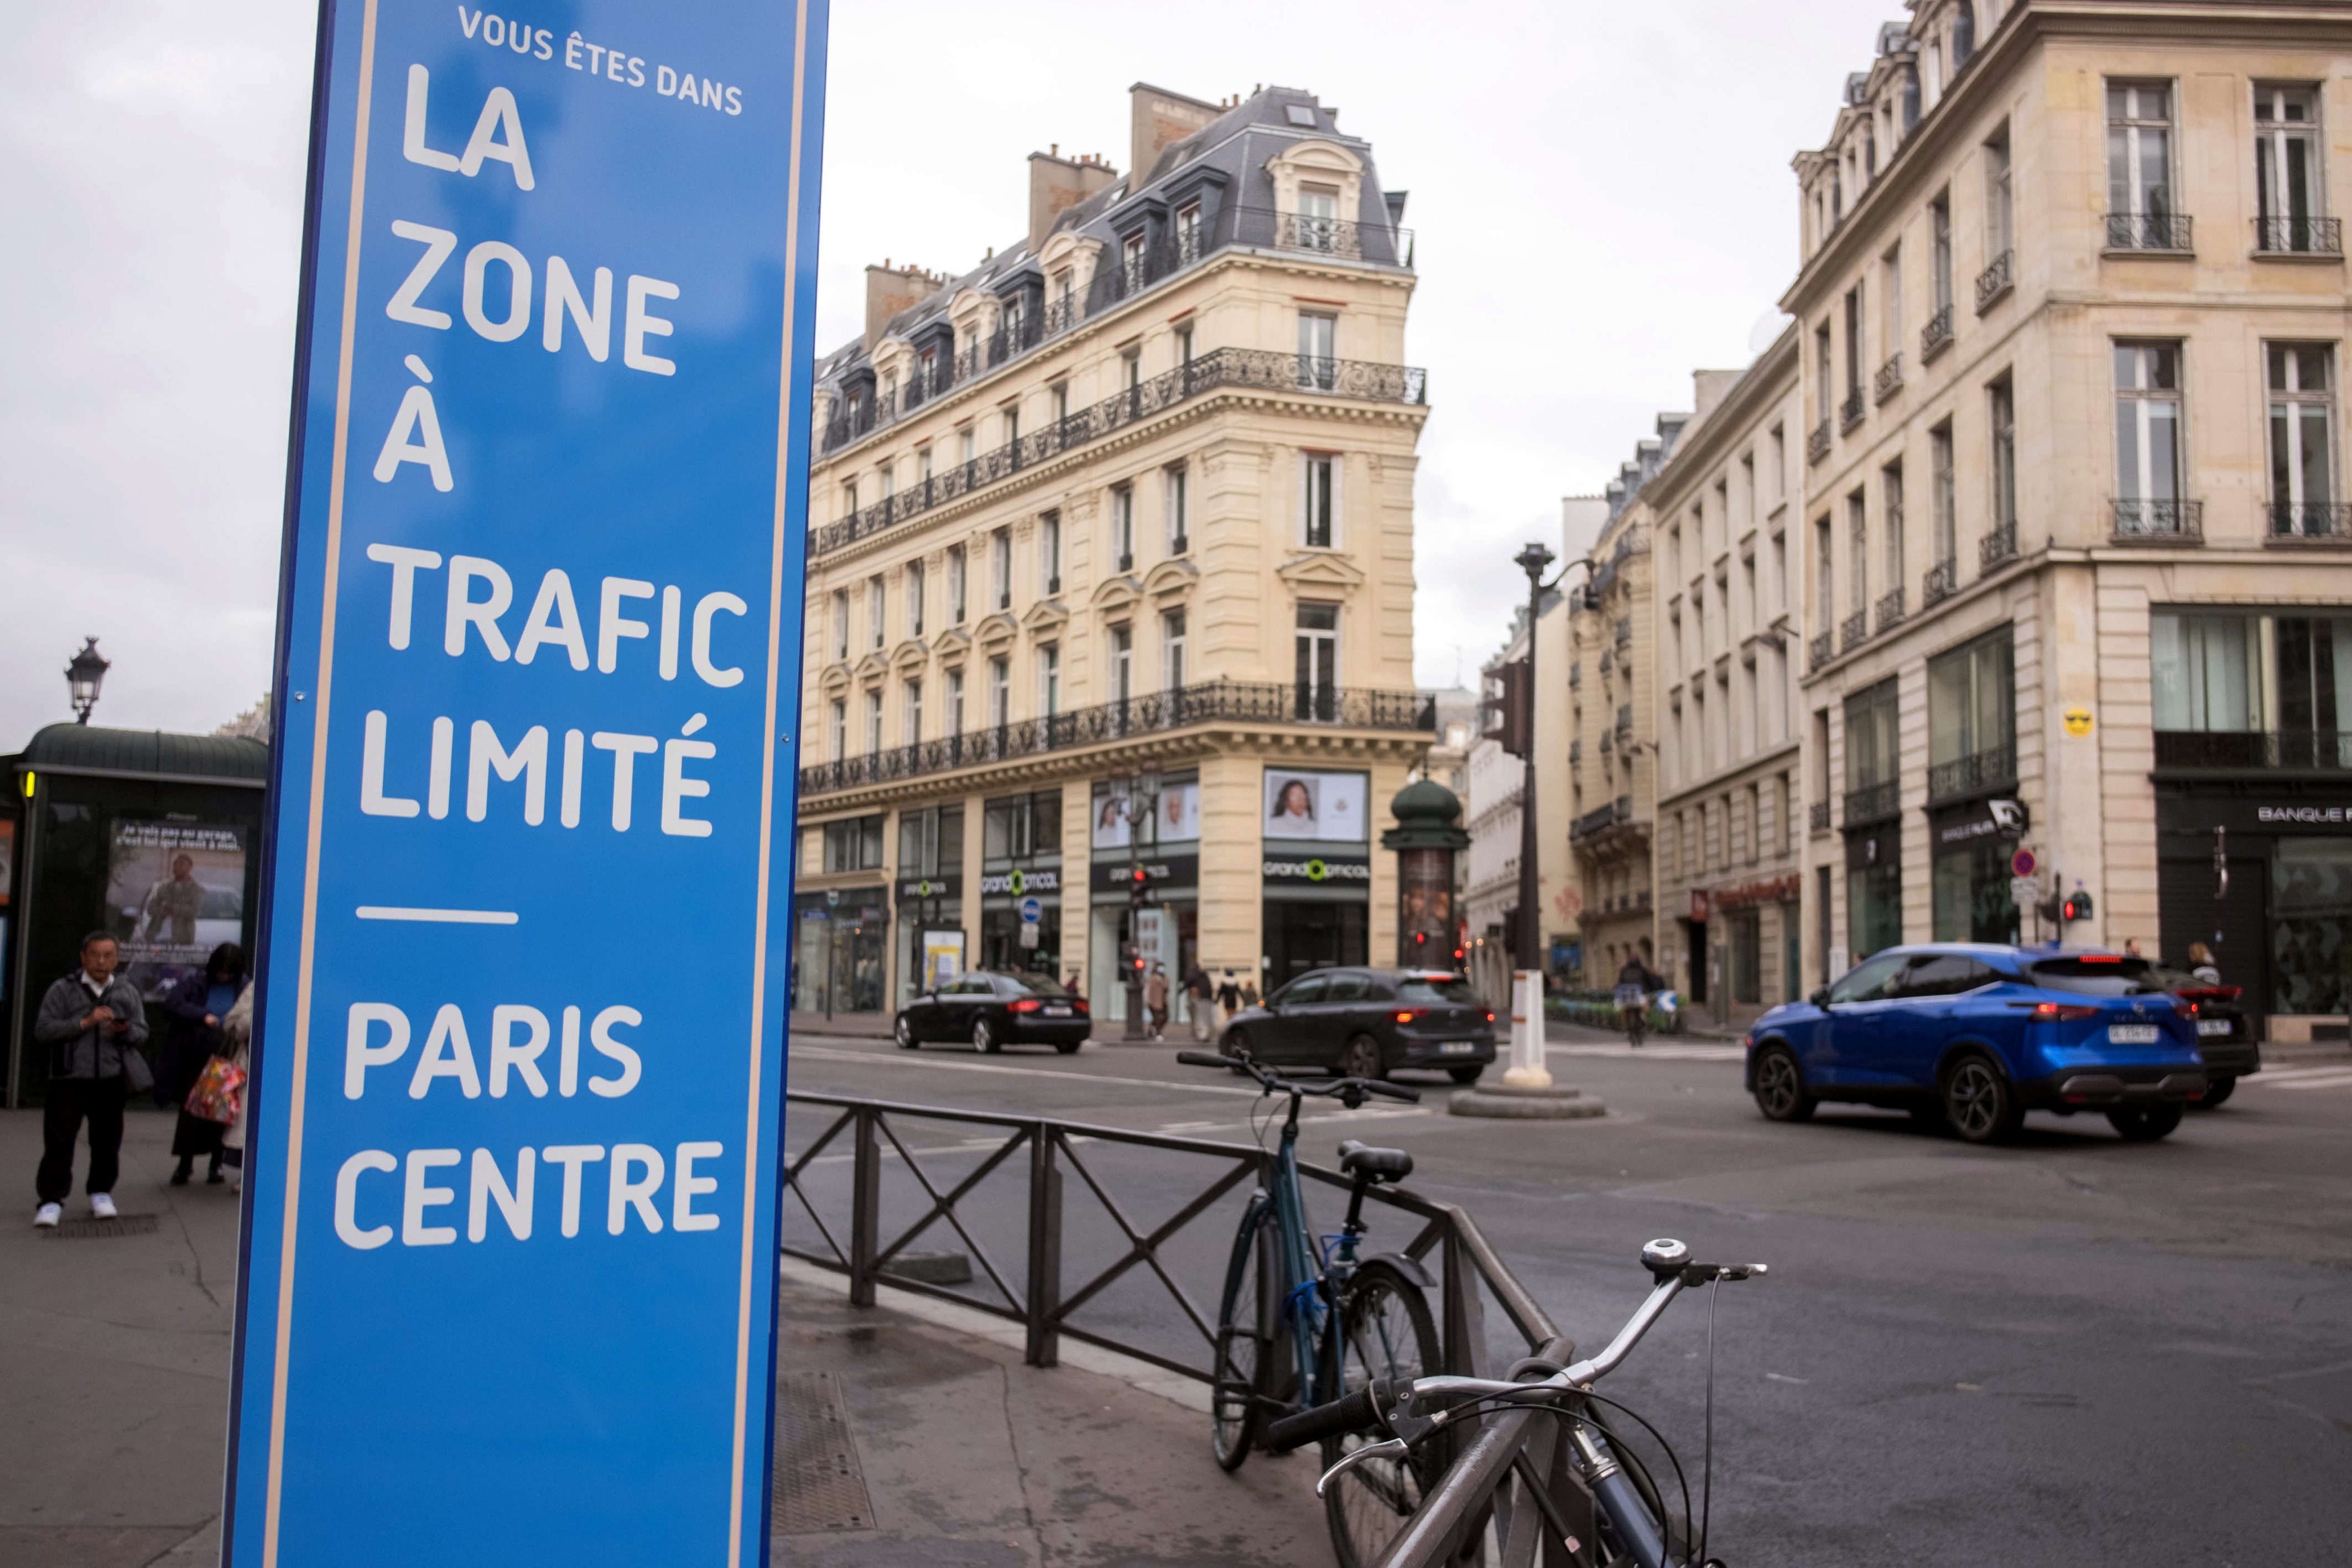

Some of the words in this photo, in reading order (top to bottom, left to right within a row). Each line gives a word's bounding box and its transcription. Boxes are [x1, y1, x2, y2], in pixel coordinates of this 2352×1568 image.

[458, 5, 553, 60] VOUS
[565, 31, 645, 87] ÊTES
[657, 65, 742, 116] DANS
[403, 64, 535, 191] LA
[386, 219, 680, 376] ZONE
[373, 354, 454, 492] À
[366, 543, 747, 687] TRAFIC
[361, 710, 716, 837] LIMITÉ
[2259, 807, 2343, 823] BANQUE
[344, 1003, 642, 1100] PARIS
[335, 1142, 723, 1249] CENTRE
